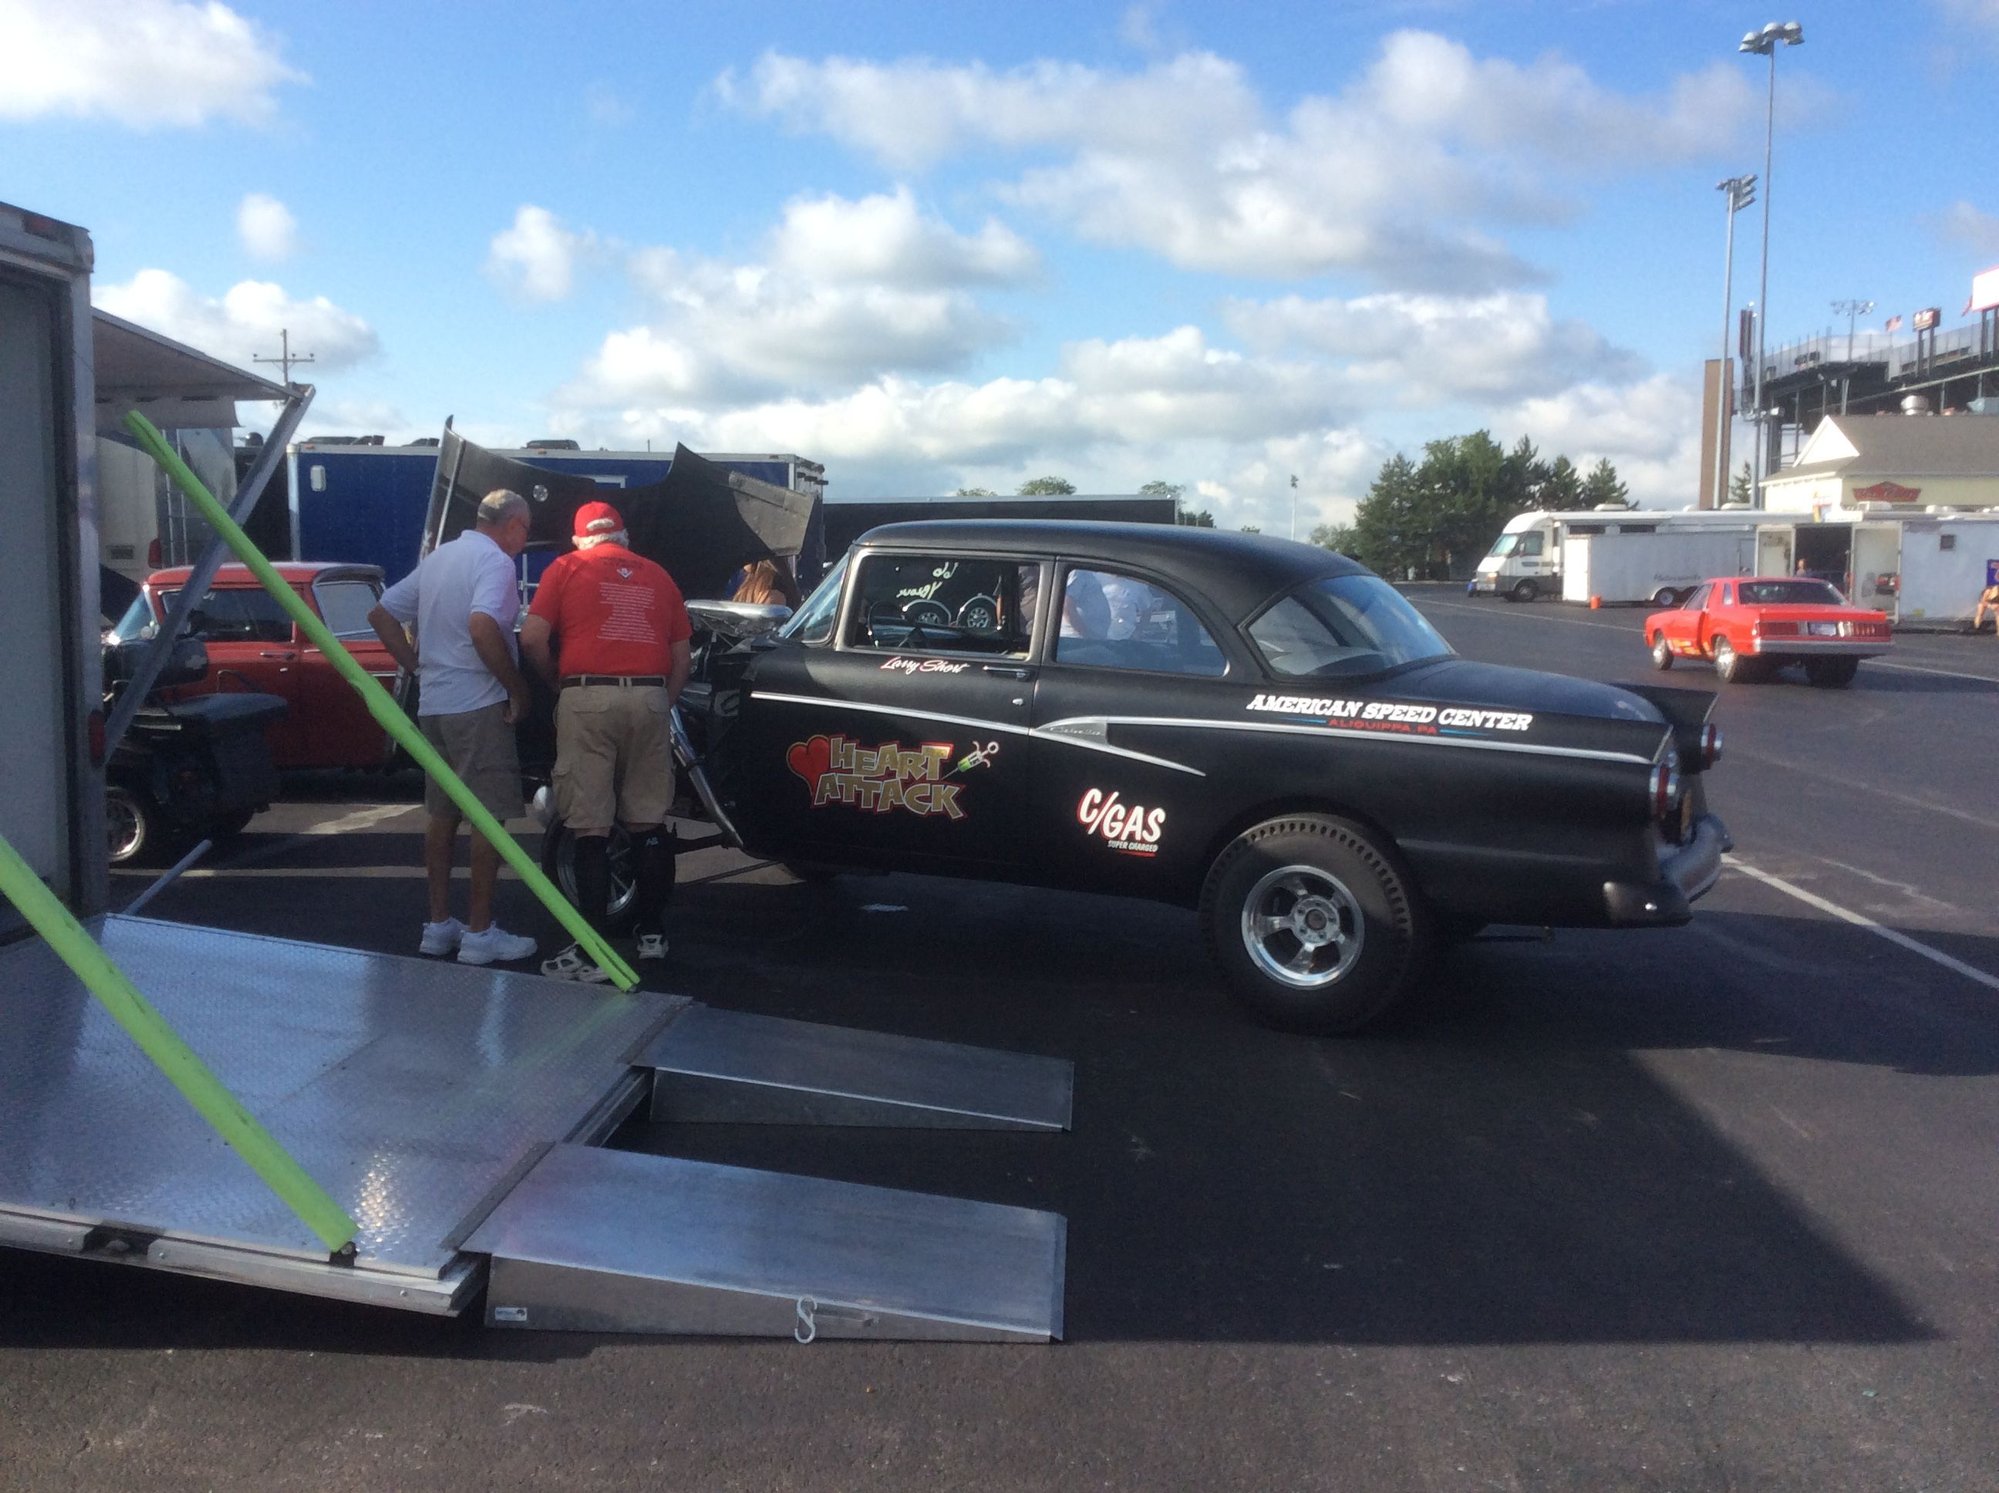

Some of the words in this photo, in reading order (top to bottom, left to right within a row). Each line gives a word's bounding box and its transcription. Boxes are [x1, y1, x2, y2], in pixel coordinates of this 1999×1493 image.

[880, 656, 920, 675] Larry
[1246, 694, 1363, 719] AMERICAN
[1361, 702, 1438, 723] SPEED
[1438, 707, 1533, 731] CENTER
[829, 736, 953, 781] HEART
[813, 775, 967, 821] ATTACK
[1077, 788, 1166, 843] C/GAS
[1107, 840, 1129, 850] SUPER
[1128, 842, 1159, 853] CHARGED
